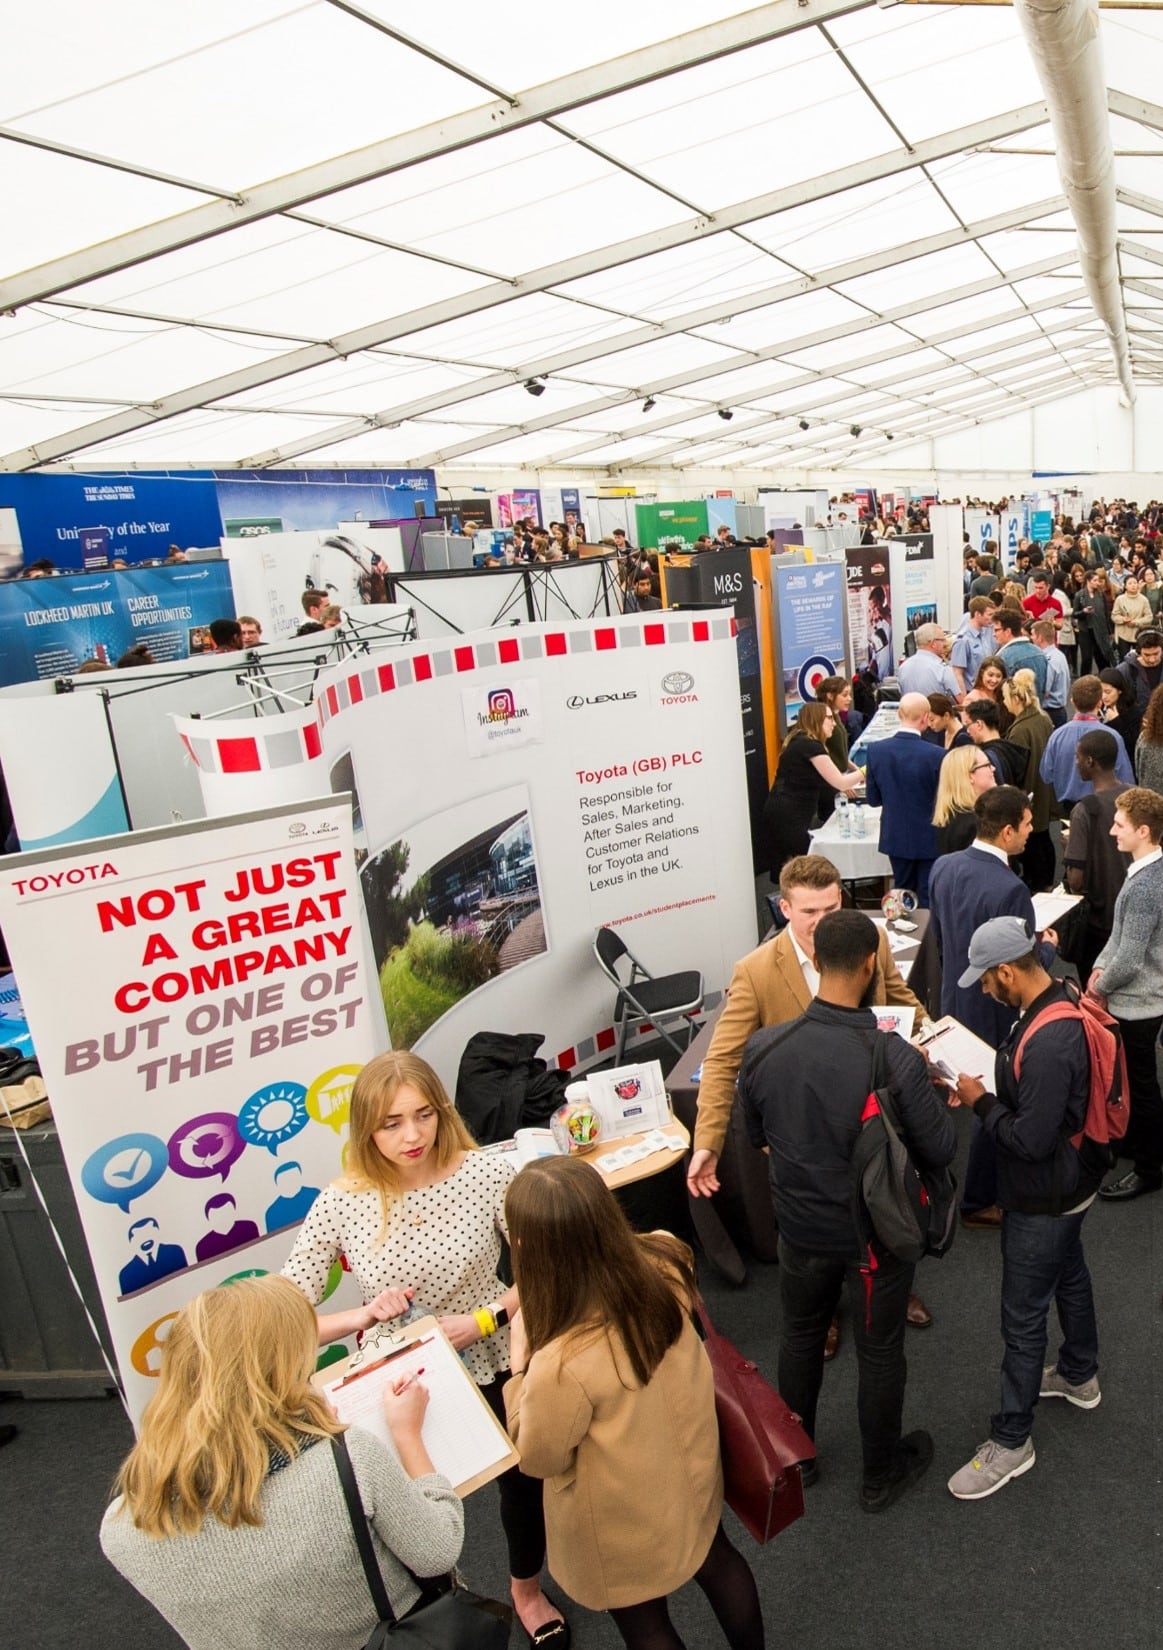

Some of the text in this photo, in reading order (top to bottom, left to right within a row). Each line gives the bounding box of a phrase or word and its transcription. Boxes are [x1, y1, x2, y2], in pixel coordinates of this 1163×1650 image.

[117, 522, 128, 536] of
[130, 521, 147, 534] the
[148, 521, 171, 534] Year
[714, 573, 742, 595] M&S
[24, 601, 115, 627] LOCKHEED MARTIN UK
[127, 595, 159, 612] CAREER
[131, 606, 192, 627] OPPORTUNITIES
[585, 690, 637, 704] LEXUS
[660, 695, 699, 706] TOYOTA
[477, 707, 529, 726] Instagram
[576, 751, 703, 785] Toyota (GB) PLC
[579, 782, 673, 809] Responsible for
[584, 813, 674, 843] After Sales and
[586, 825, 699, 859] Customer Relations
[588, 845, 669, 875] for Toyota and
[12, 862, 119, 896] TOYOTA
[589, 859, 683, 892] Lexus in the UK.
[96, 851, 342, 933] NOT JUST
[142, 889, 348, 967] A GREAT
[114, 925, 353, 1014] COMPANY
[64, 961, 359, 1076] BUT ONE OF
[136, 997, 364, 1092] THE BEST
